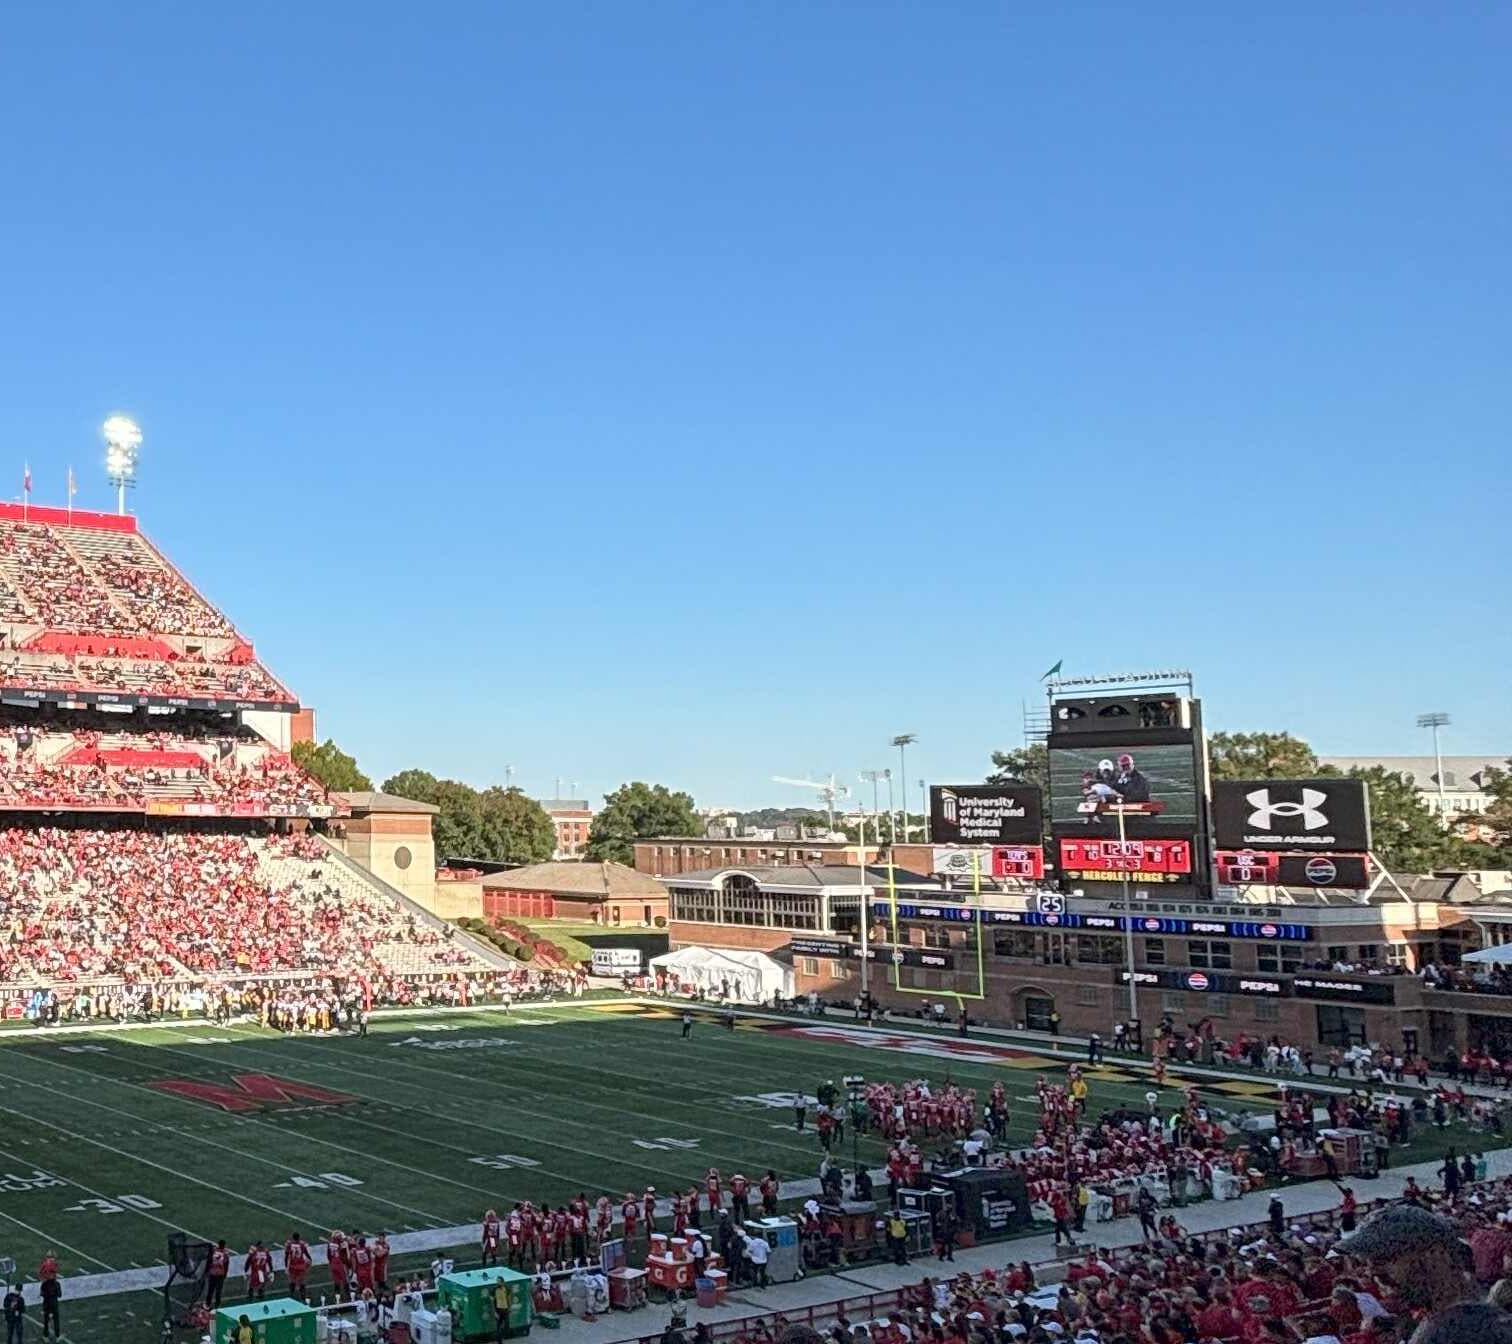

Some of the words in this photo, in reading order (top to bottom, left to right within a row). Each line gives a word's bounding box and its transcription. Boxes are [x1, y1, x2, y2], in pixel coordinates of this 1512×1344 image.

[958, 796, 1014, 807] University
[959, 807, 972, 817] of
[973, 807, 1025, 818] Maryland
[959, 818, 1002, 827] Medical
[959, 827, 1001, 838] System
[1243, 835, 1282, 843] UNDER
[1283, 836, 1335, 844] ARMOUR
[1041, 897, 1062, 912] 25
[994, 913, 1021, 922] PEPSI
[1086, 917, 1115, 929] PEPSI
[1192, 923, 1226, 933] PEPSI
[1240, 980, 1280, 992] PEPSI
[467, 1154, 543, 1170] 50
[290, 1172, 365, 1190] 40
[79, 1194, 163, 1214] 30
[654, 1268, 664, 1280] G
[676, 1266, 688, 1283] G
